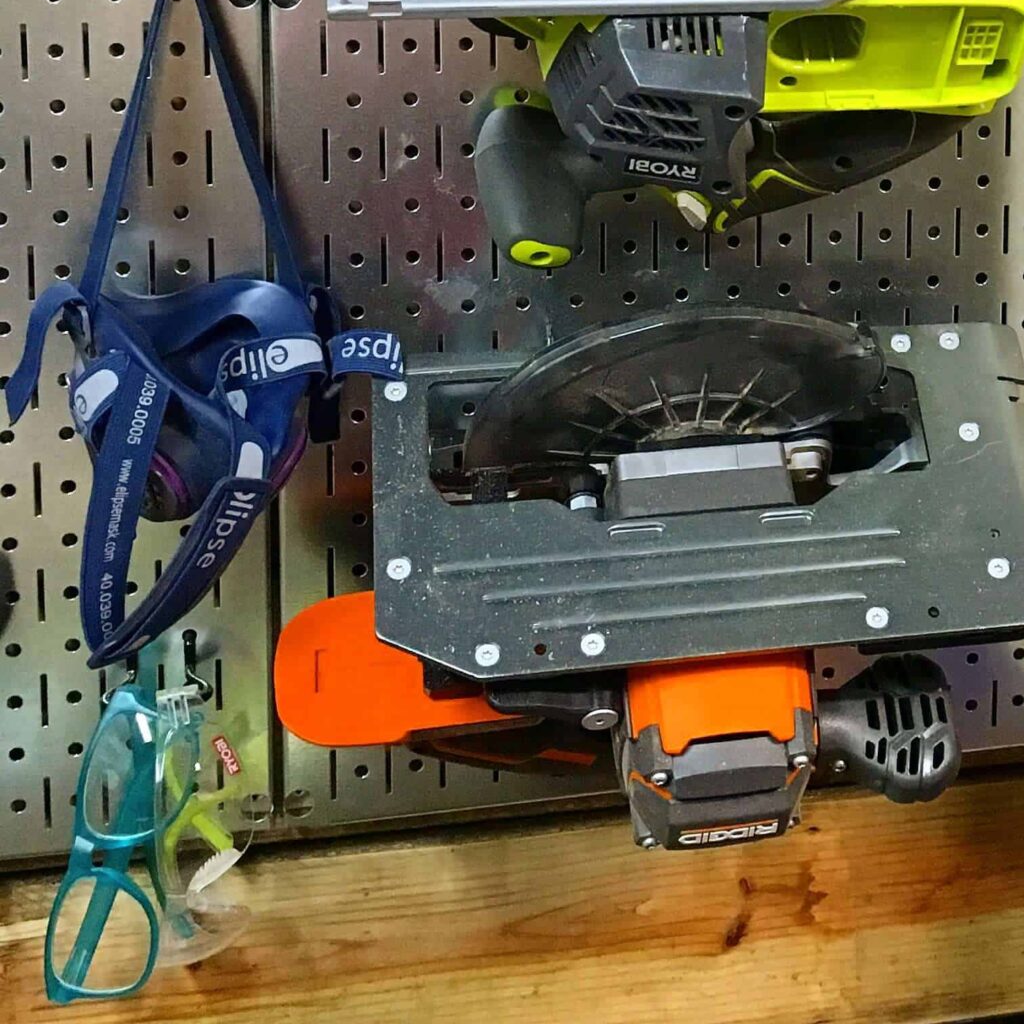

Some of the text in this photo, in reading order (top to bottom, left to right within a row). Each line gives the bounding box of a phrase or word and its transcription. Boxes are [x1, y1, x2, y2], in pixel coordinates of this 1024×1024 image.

[628, 157, 697, 180] RYOBI
[103, 458, 134, 563] www.elipsemask.com
[196, 492, 254, 568] lipse
[214, 737, 239, 775] RYOBI
[678, 822, 779, 845] RIDGID
